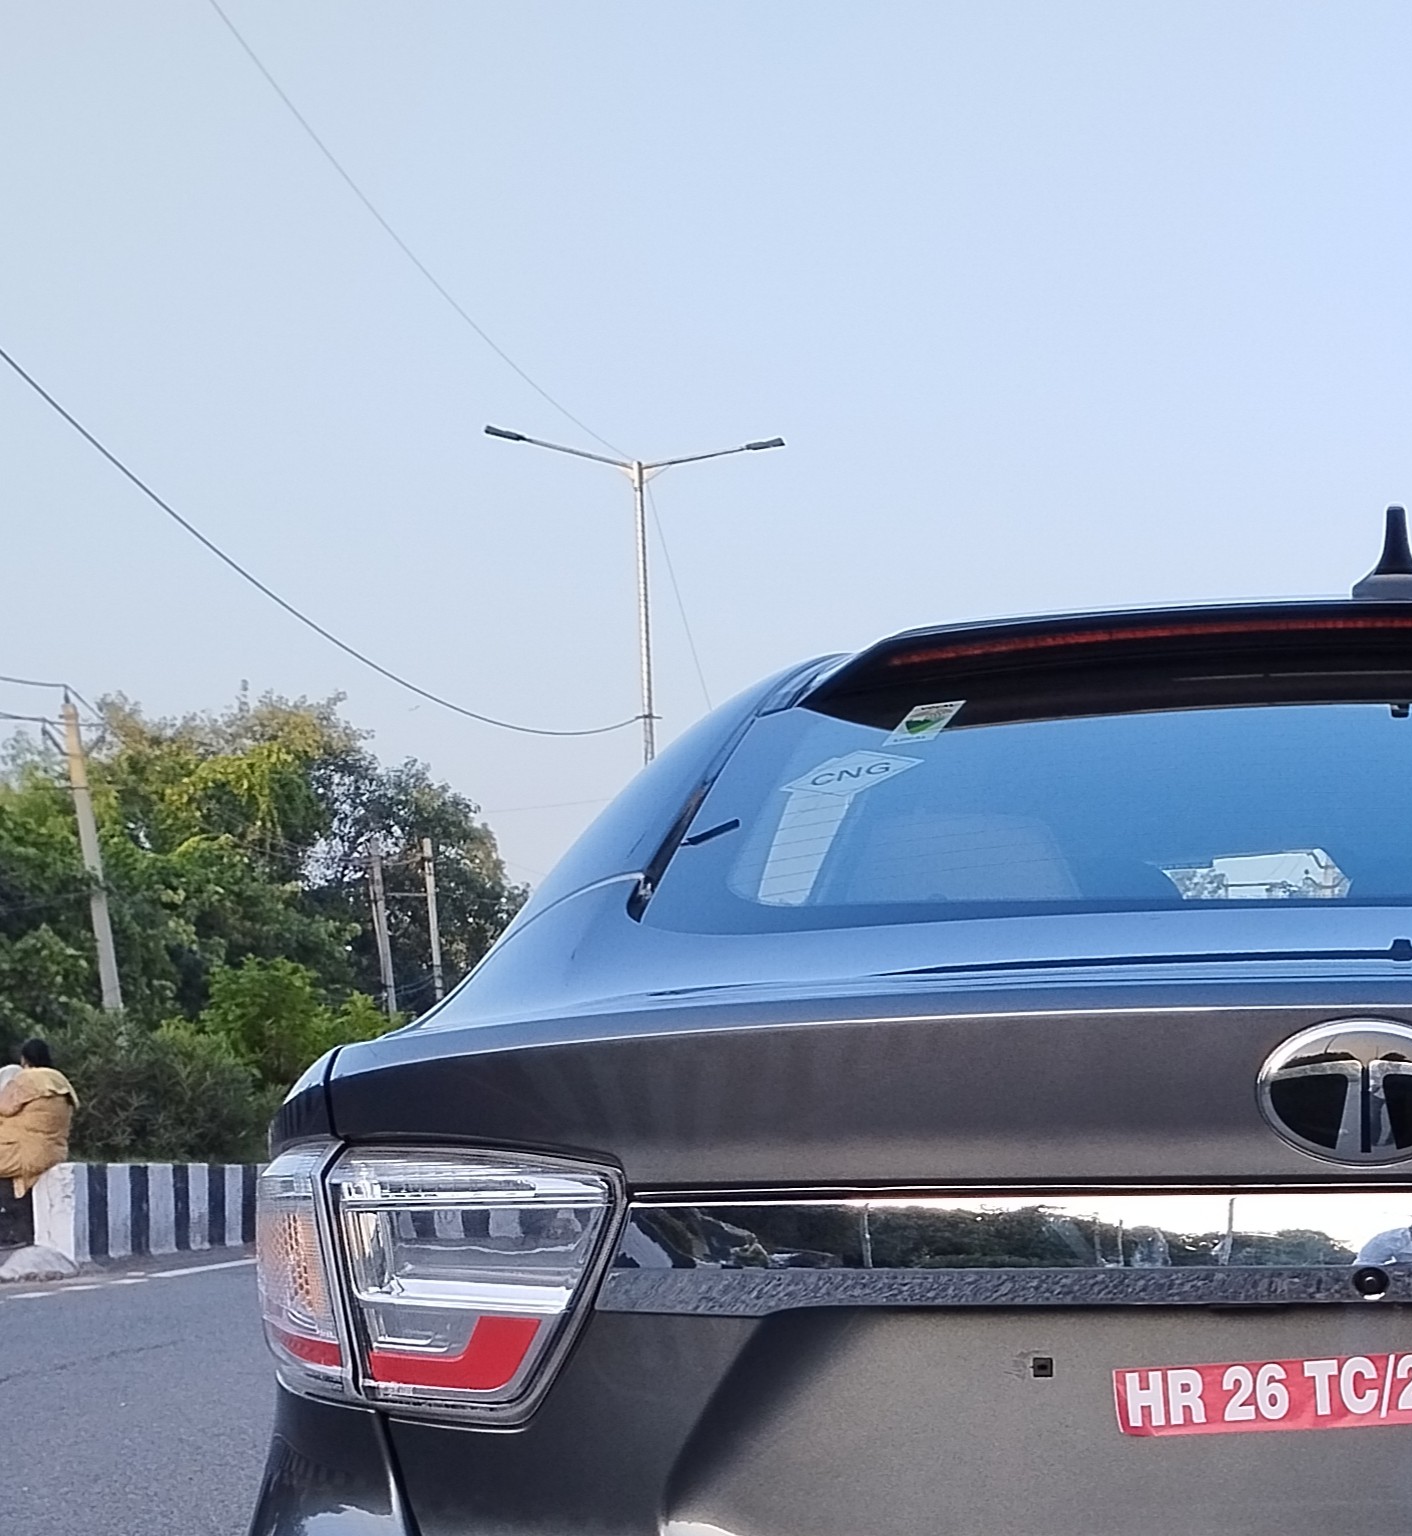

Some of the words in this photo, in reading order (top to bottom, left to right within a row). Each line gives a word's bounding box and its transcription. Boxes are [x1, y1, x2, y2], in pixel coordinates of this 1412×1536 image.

[811, 762, 891, 786] CNG
[1125, 1369, 1207, 1427] HR
[1222, 1363, 1289, 1422] 26
